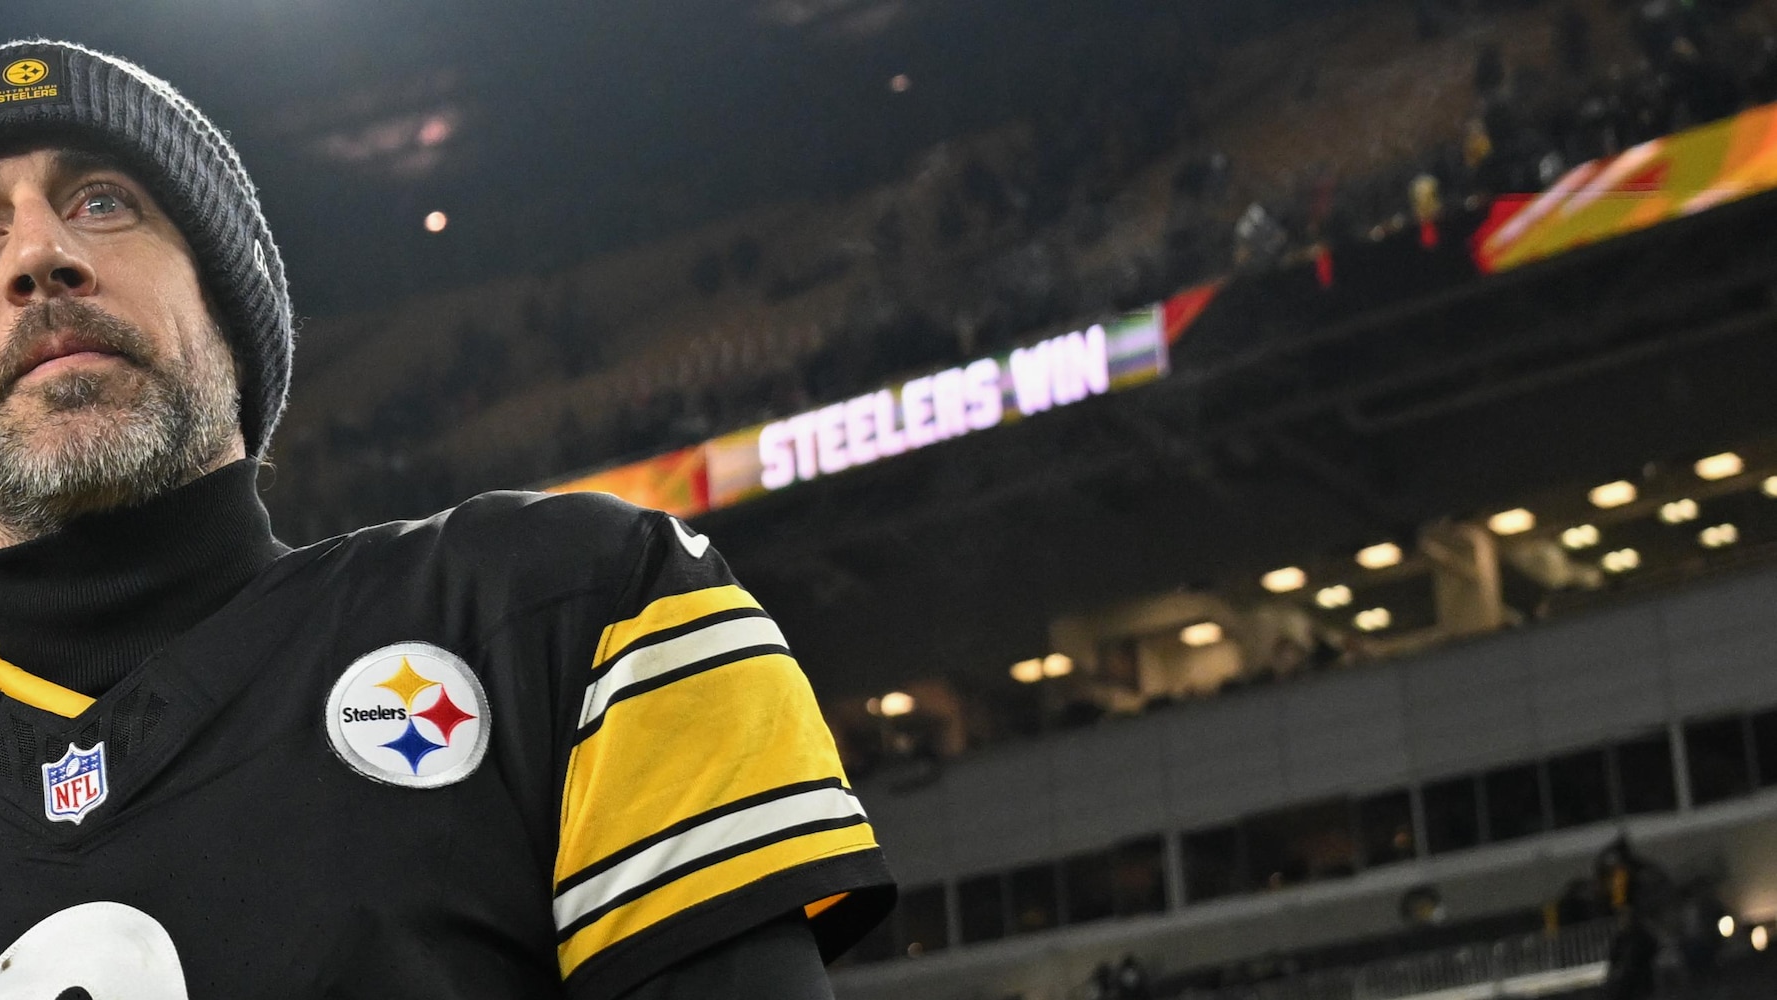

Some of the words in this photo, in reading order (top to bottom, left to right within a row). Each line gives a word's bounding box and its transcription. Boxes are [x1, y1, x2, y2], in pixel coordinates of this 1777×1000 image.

[758, 357, 1004, 490] STEELERS
[1009, 323, 1110, 416] WIN
[342, 705, 407, 723] Steelers
[55, 775, 98, 809] NFL
